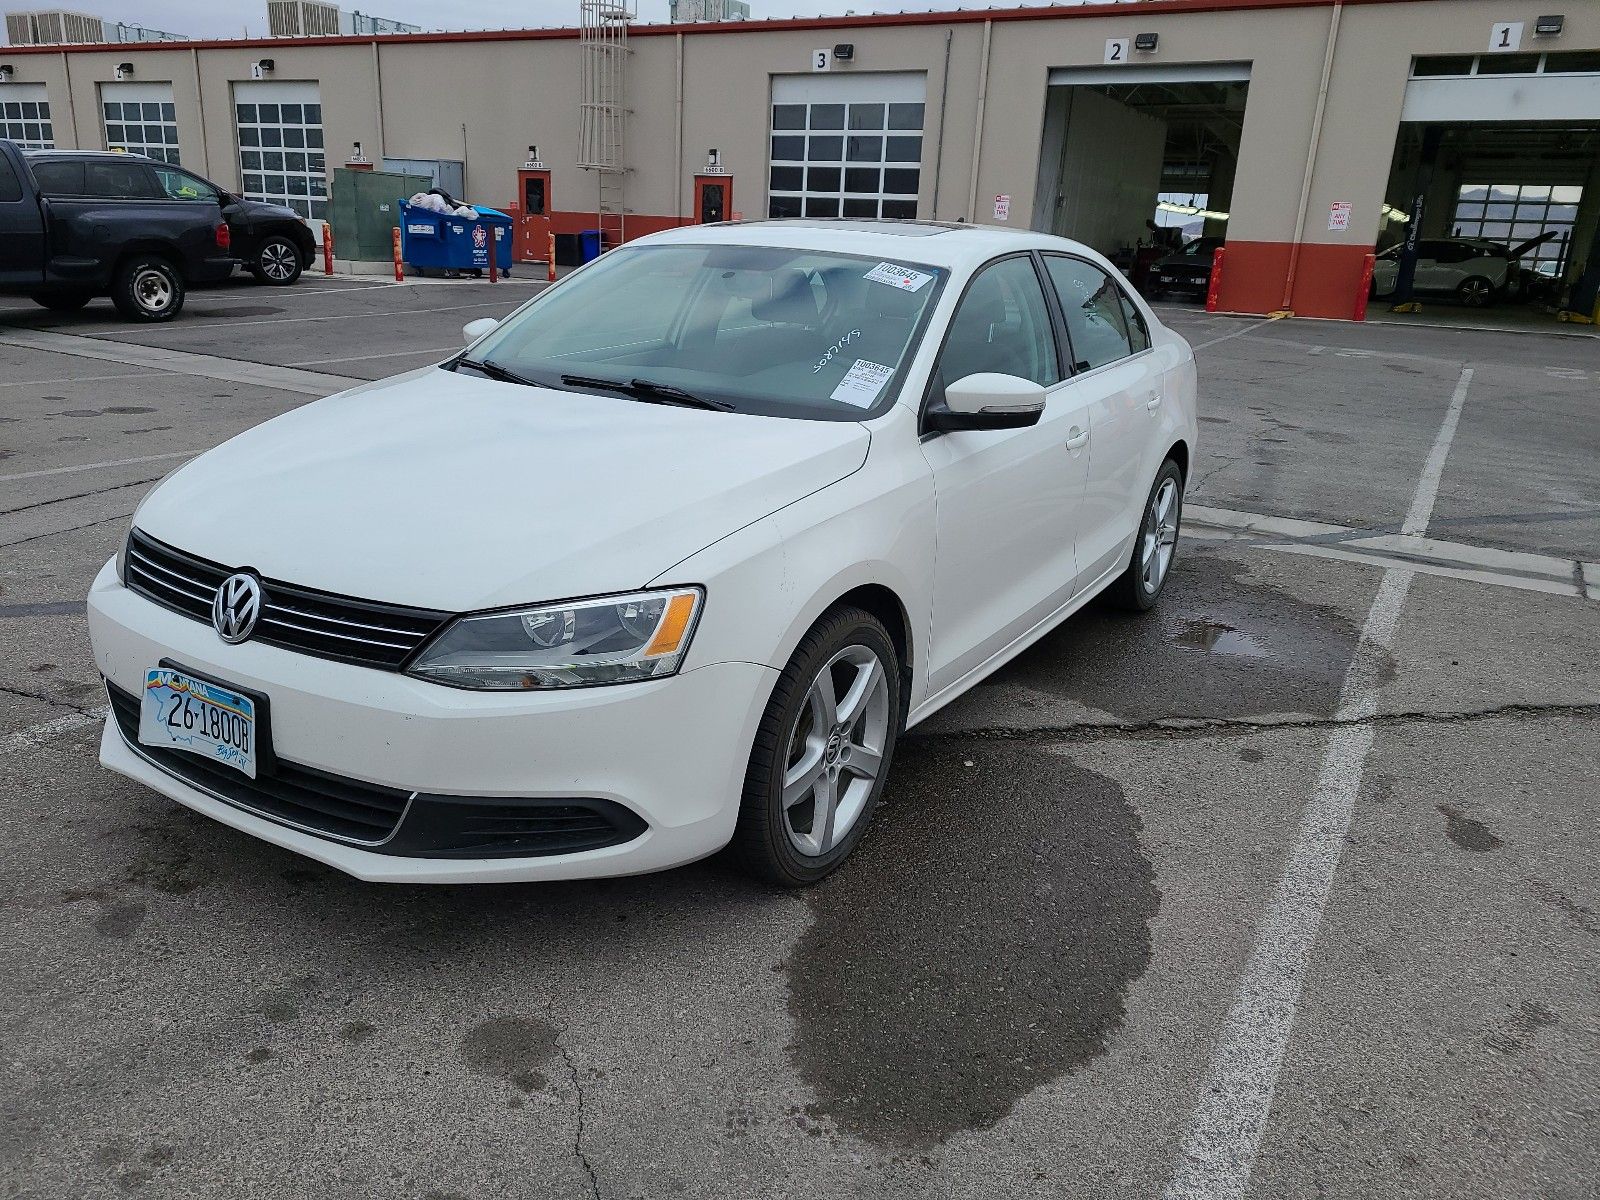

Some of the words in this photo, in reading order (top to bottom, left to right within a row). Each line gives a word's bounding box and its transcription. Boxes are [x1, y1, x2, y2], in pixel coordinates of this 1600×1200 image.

[1499, 27, 1510, 47] 1
[818, 52, 826, 68] 3
[1111, 43, 1121, 60] 2
[255, 66, 259, 77] 1
[877, 263, 920, 281] 1003645
[857, 360, 890, 374] 1003645
[214, 575, 259, 641] VW
